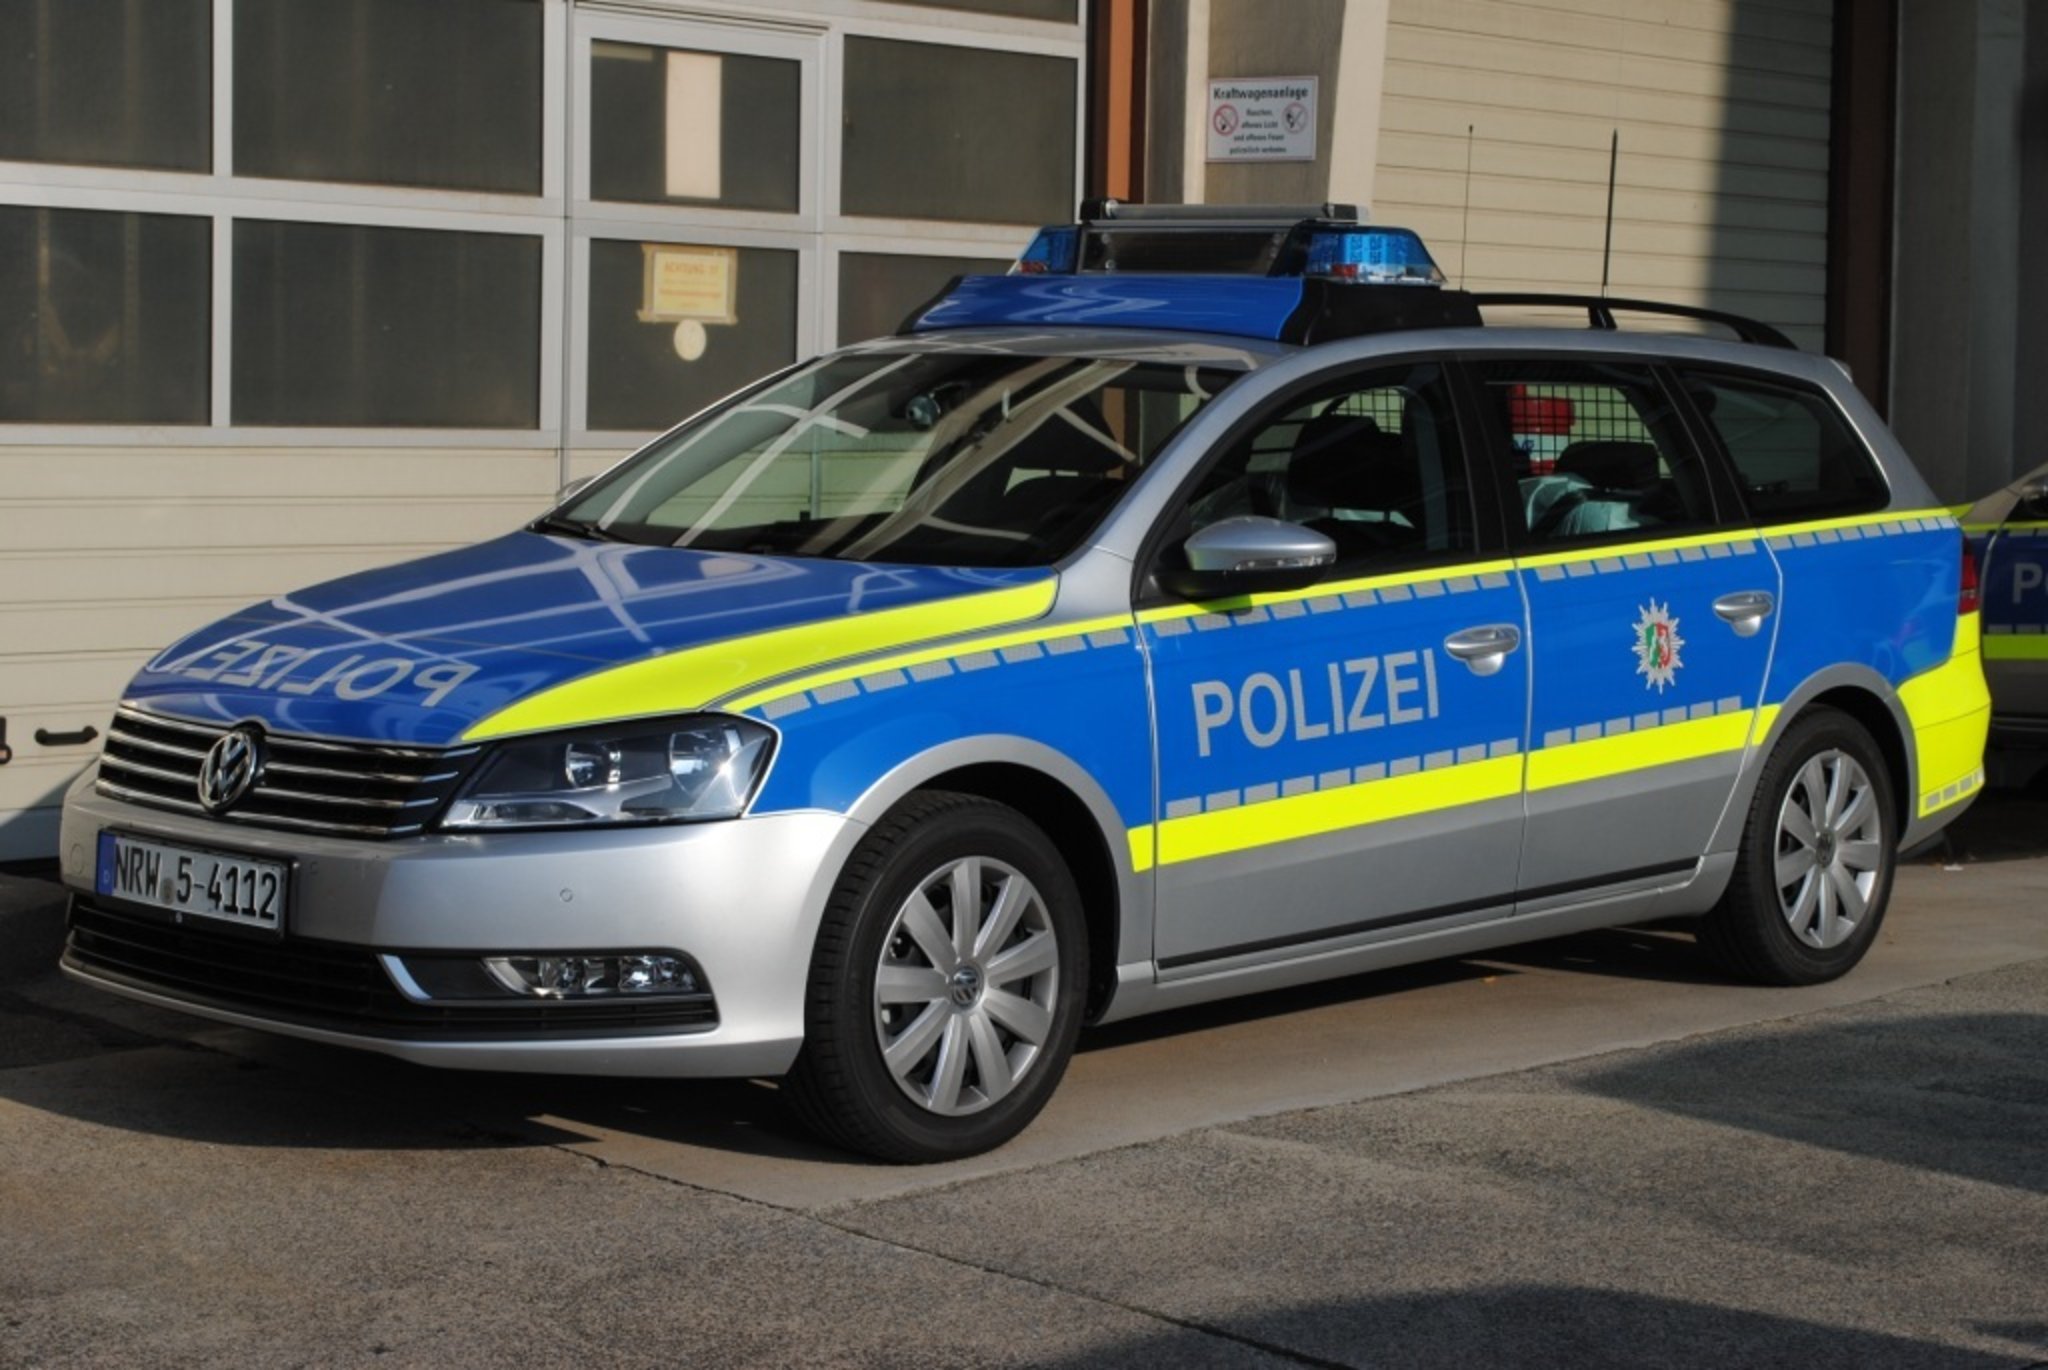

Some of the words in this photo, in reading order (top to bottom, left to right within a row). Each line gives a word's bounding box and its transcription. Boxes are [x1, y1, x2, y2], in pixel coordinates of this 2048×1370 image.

[2012, 562, 2048, 604] P
[1191, 648, 1439, 757] POLIZEI
[114, 843, 162, 899] NRW
[176, 856, 278, 921] 5-4112
